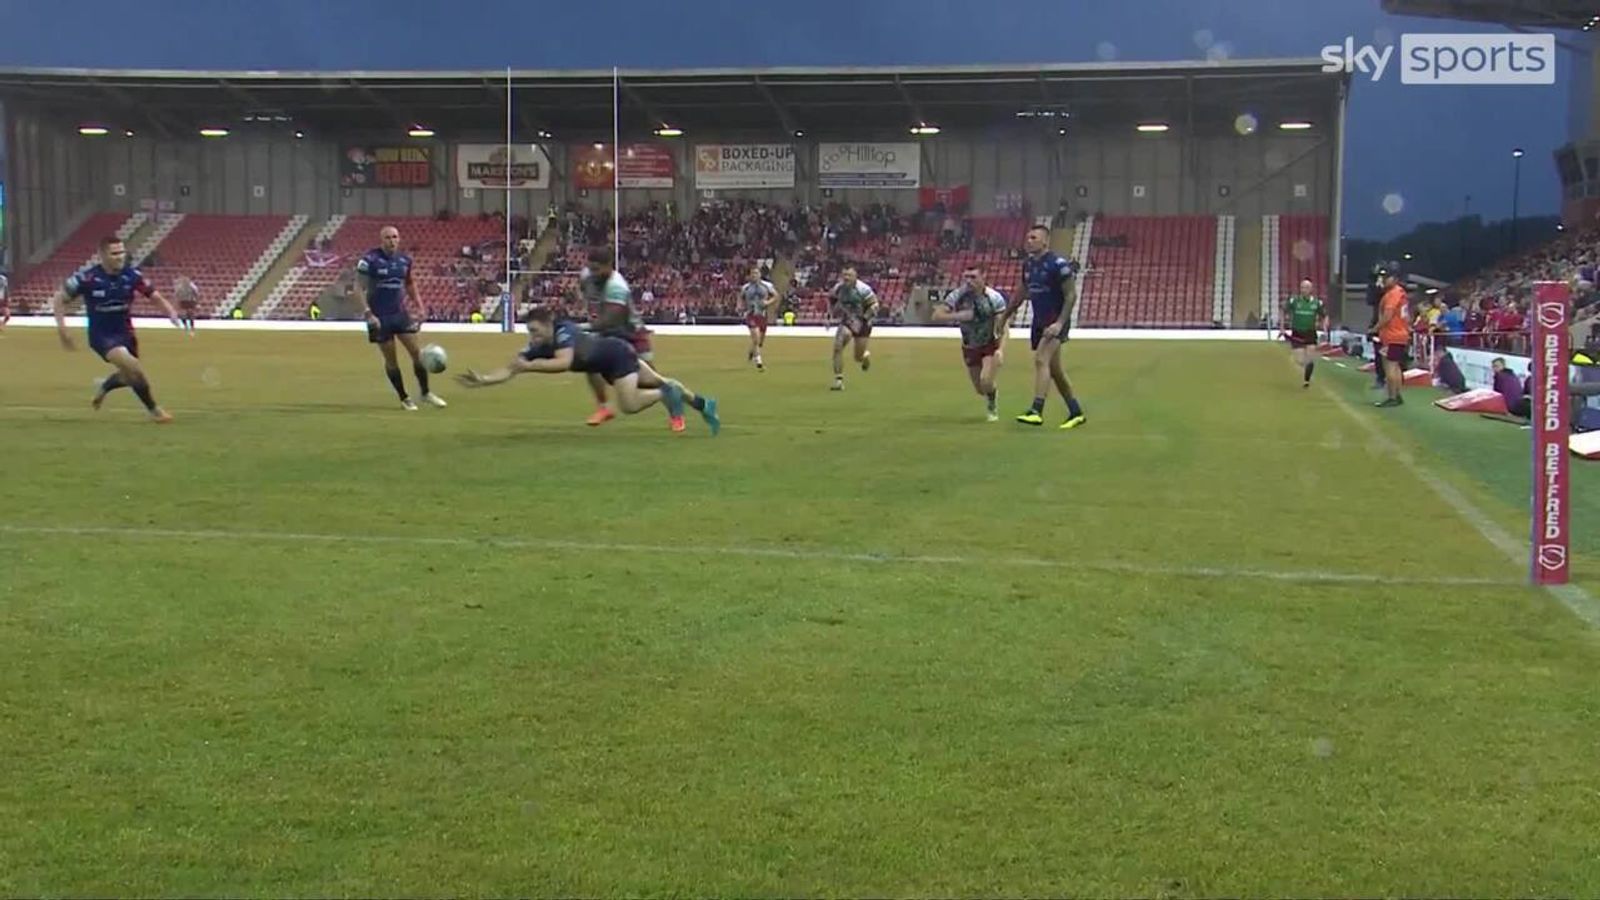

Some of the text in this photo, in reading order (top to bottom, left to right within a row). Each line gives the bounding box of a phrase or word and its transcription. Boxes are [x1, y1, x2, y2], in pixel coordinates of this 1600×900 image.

[721, 147, 794, 160] BOXED-UP
[721, 160, 794, 172] PACKAGING
[1545, 335, 1560, 430] BETFRED
[1545, 443, 1560, 538] BETFRED
